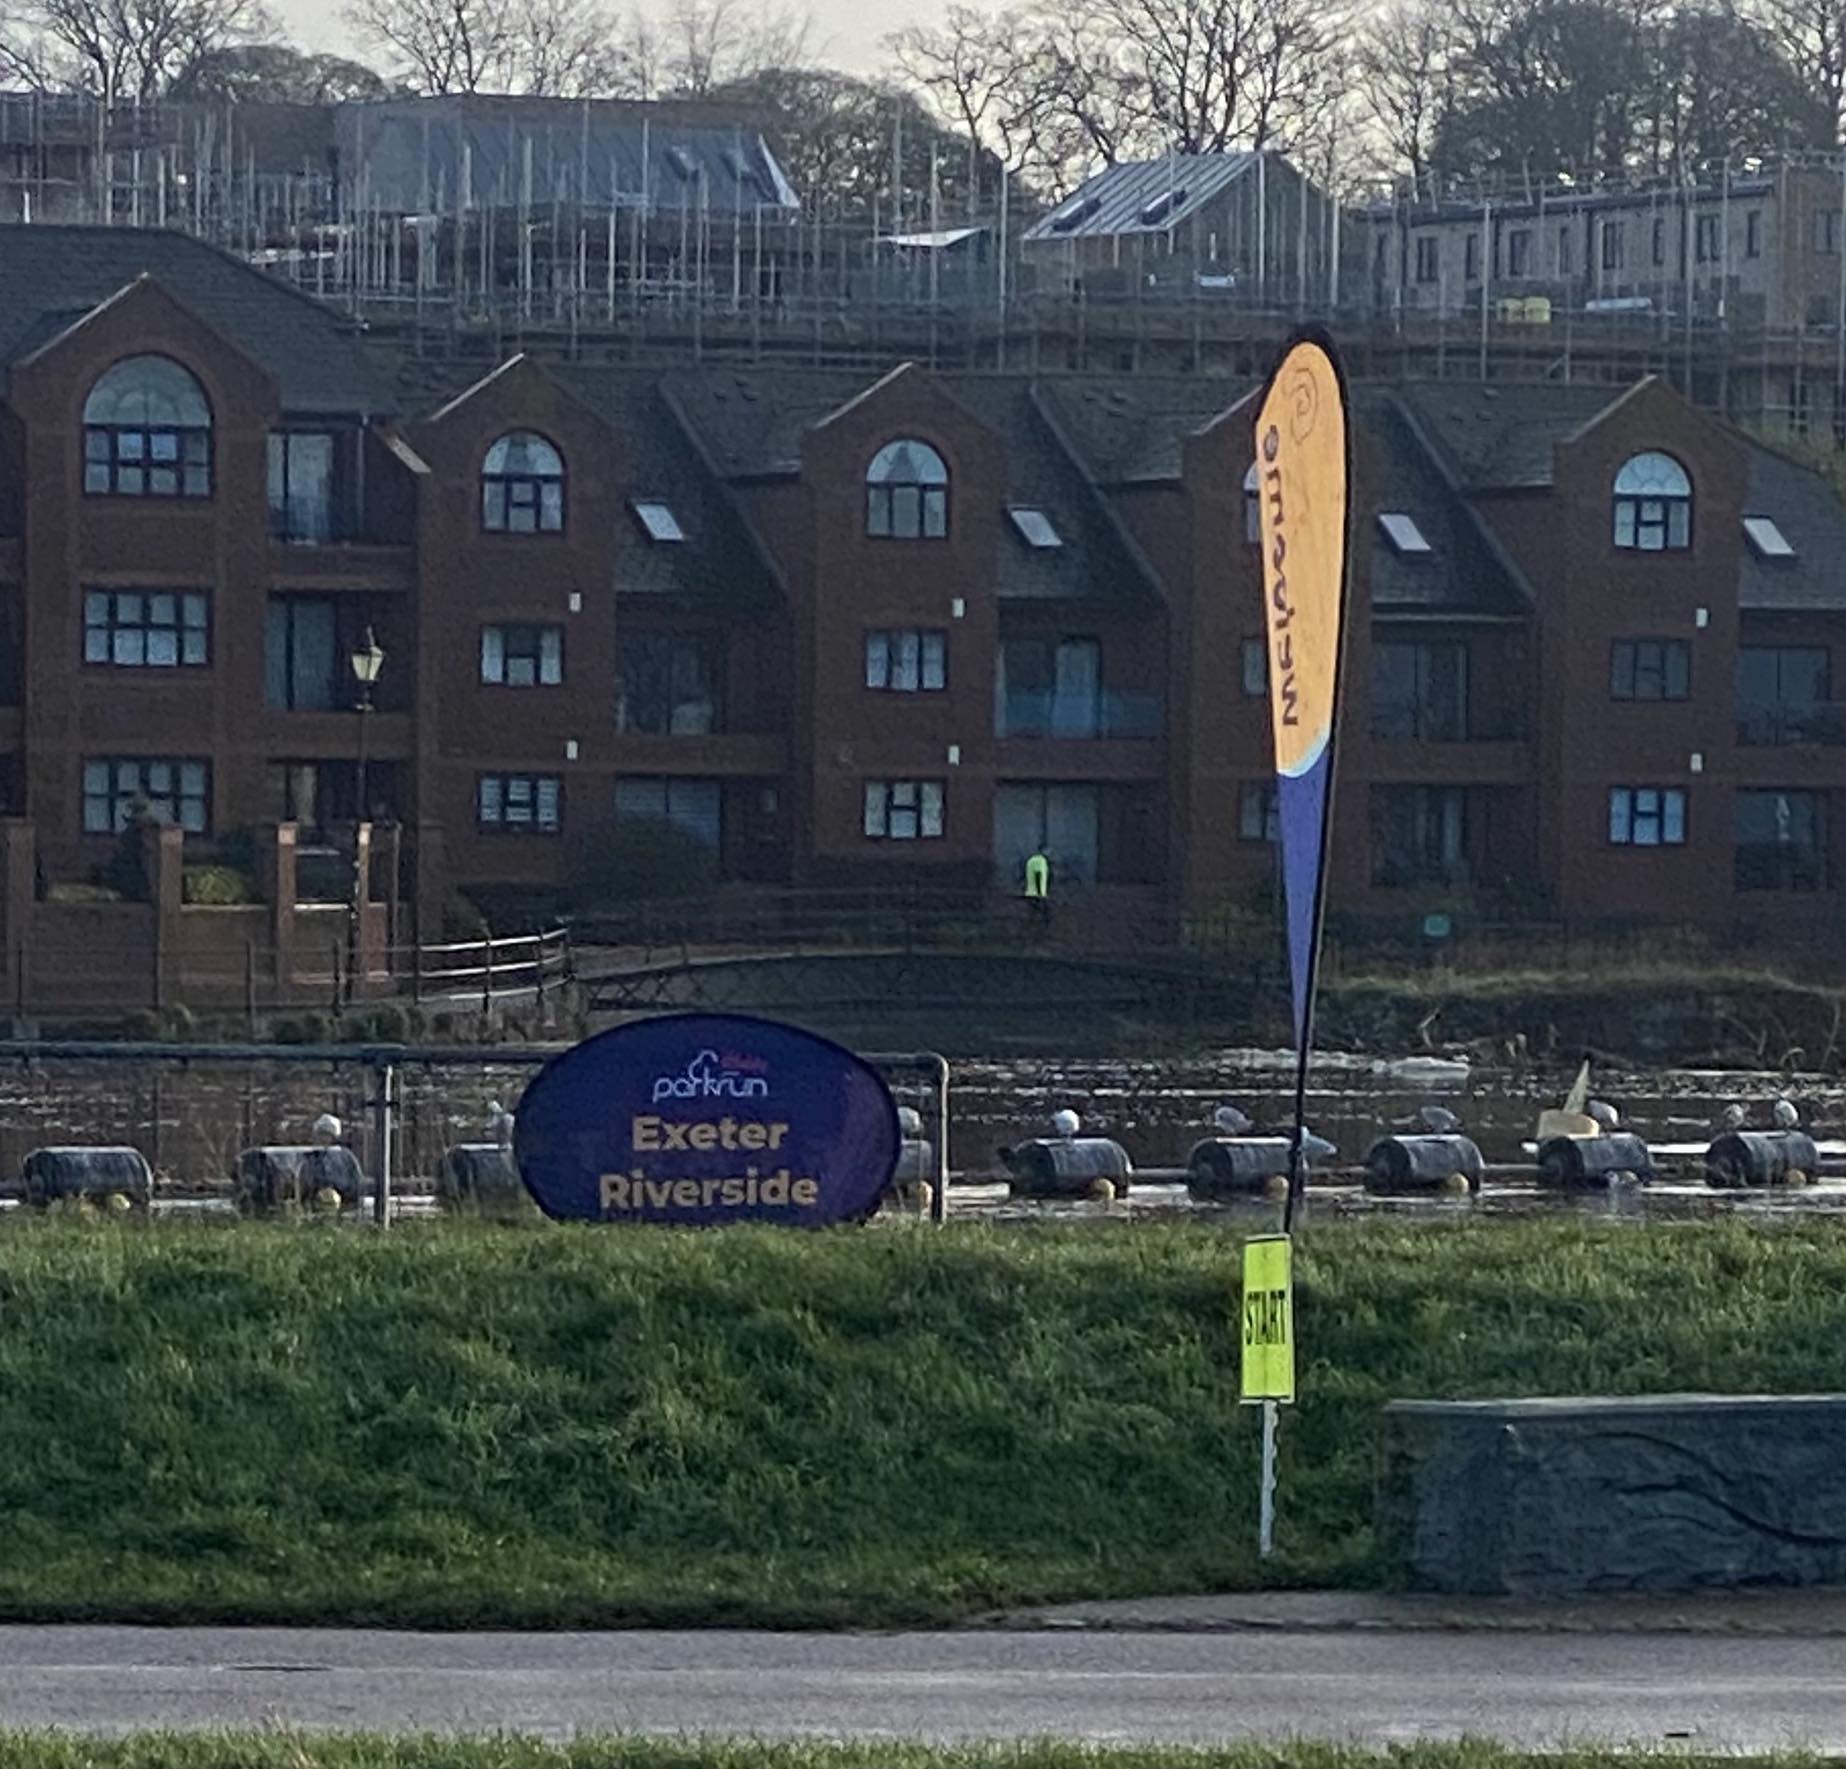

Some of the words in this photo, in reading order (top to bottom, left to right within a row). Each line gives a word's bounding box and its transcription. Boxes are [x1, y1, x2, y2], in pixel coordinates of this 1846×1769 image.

[652, 1051, 768, 1104] parkrun
[632, 1115, 789, 1150] Exeter
[600, 1166, 819, 1208] Riverside
[1245, 1289, 1286, 1346] START
